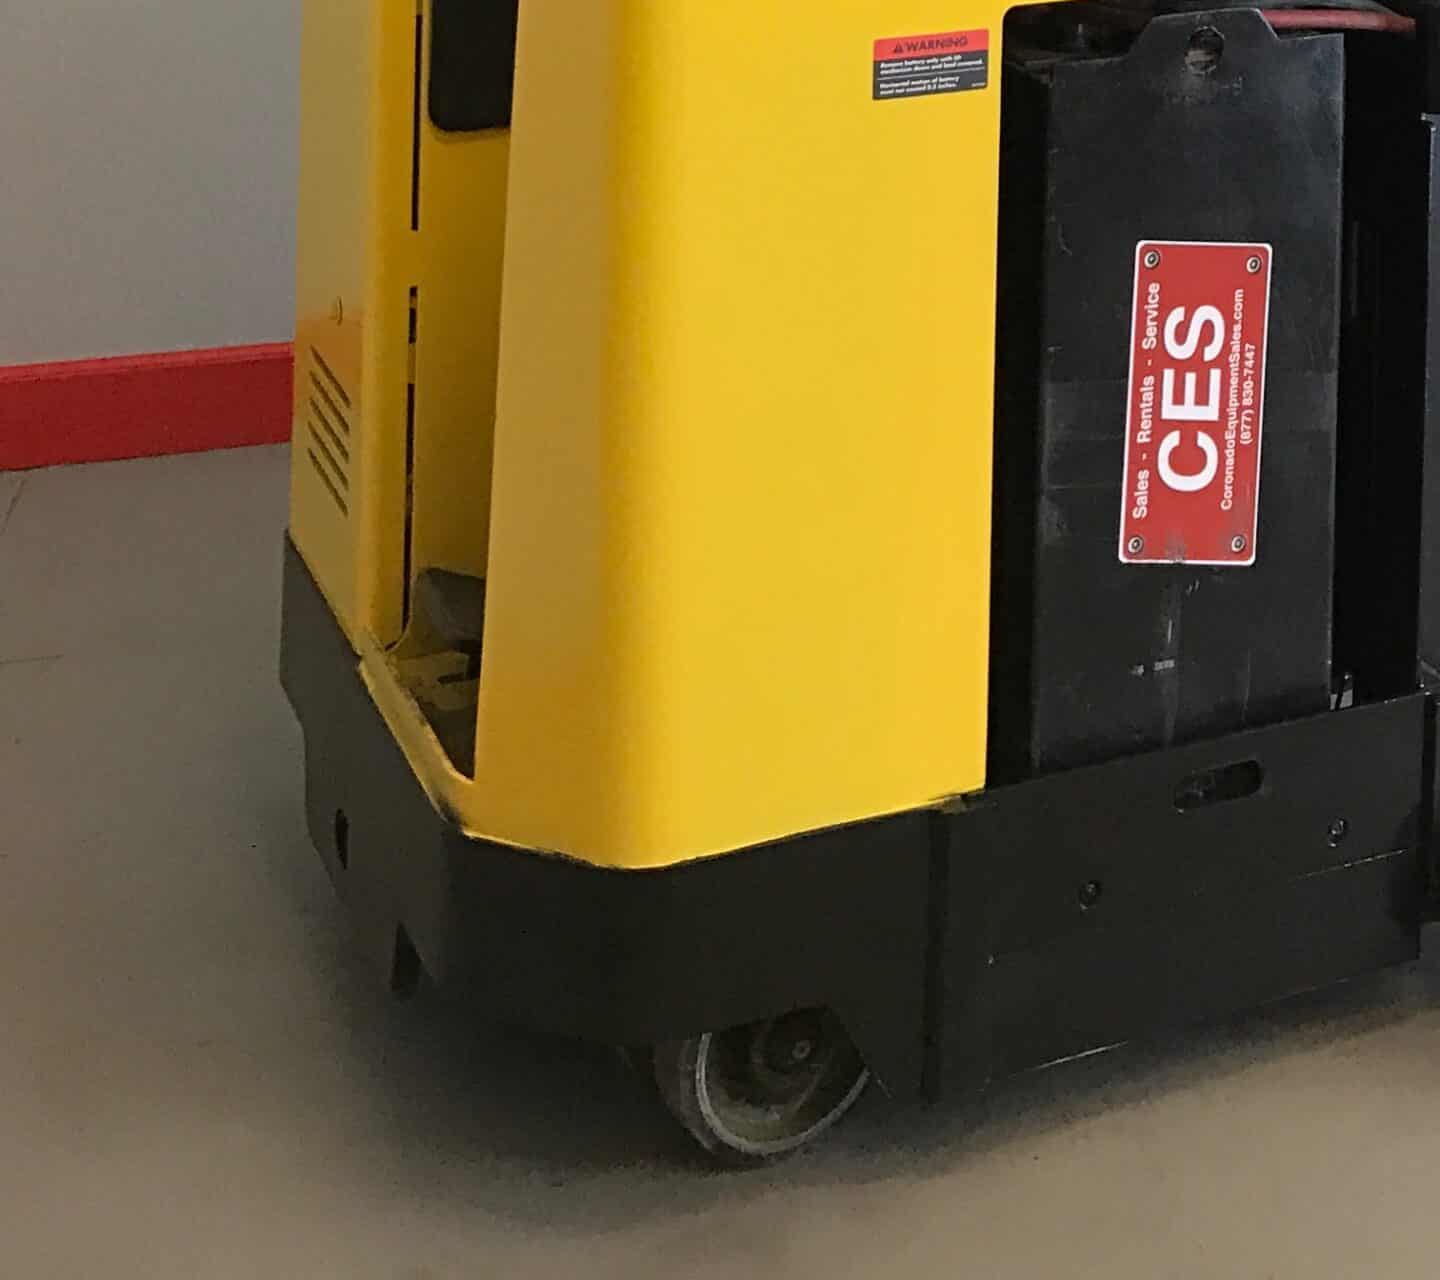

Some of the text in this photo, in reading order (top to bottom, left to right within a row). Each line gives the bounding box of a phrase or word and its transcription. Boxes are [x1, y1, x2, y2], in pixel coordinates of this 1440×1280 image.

[1141, 282, 1160, 350] Service
[1136, 375, 1155, 444] Rentals
[1156, 304, 1226, 494] CES
[1220, 288, 1245, 511] CoronadoEquipmentSales.com
[1239, 409, 1254, 445] (877)
[1132, 469, 1150, 519] Sales
